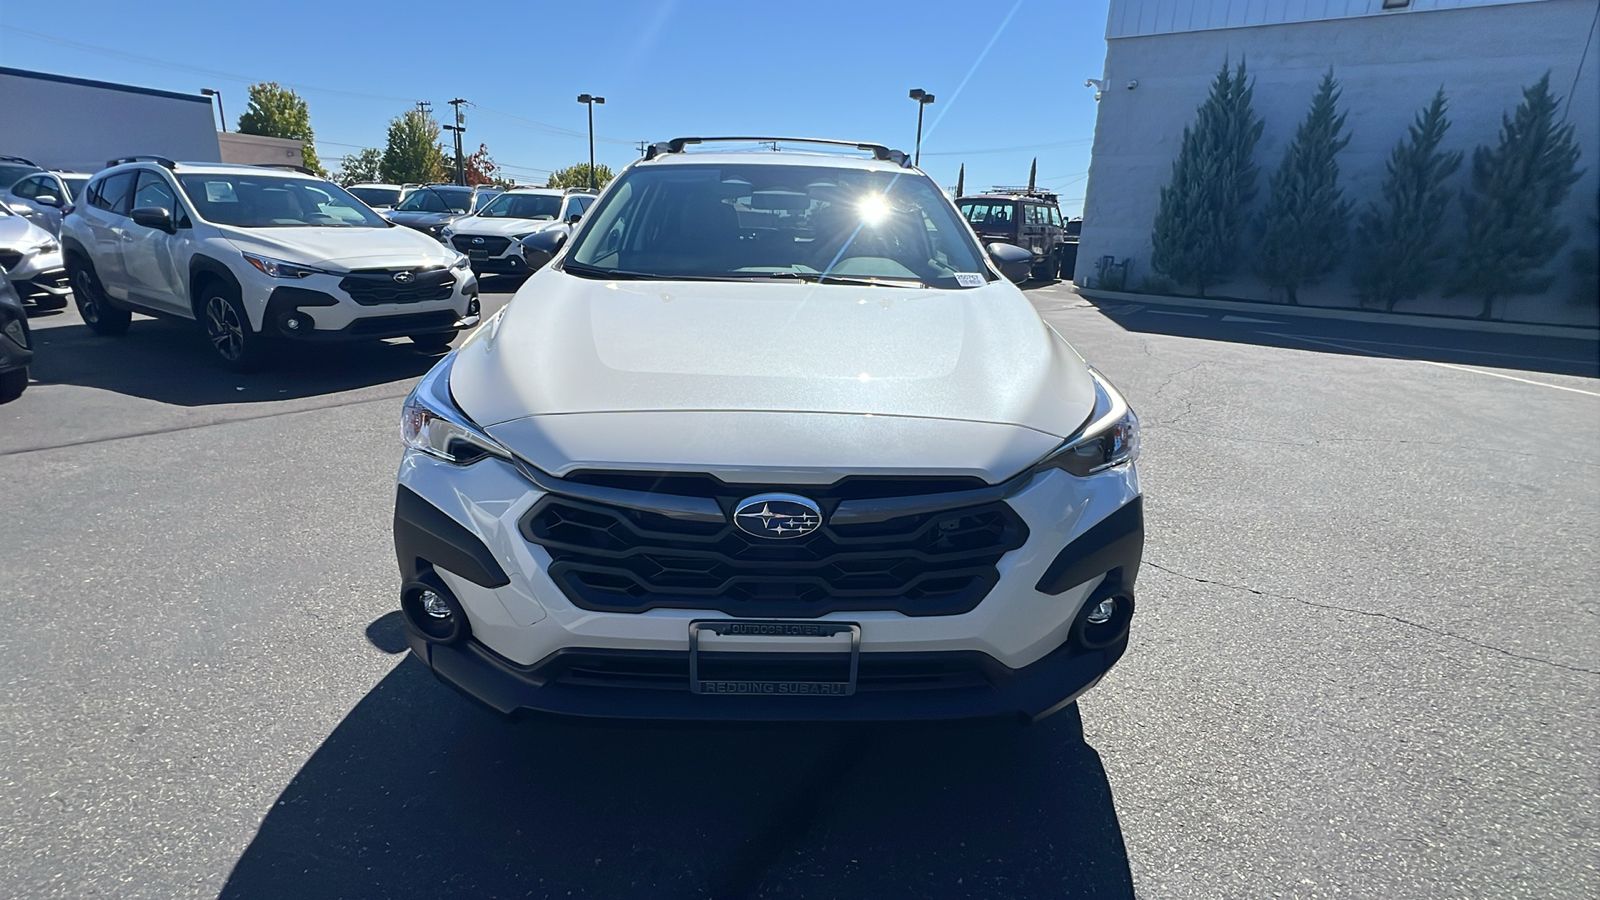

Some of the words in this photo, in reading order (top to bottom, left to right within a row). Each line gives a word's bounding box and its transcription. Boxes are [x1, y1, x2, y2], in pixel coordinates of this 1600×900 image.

[732, 624, 783, 635] OUTDOOR
[786, 625, 819, 636] LOVER
[705, 682, 773, 694] REDDING
[778, 683, 841, 695] SUBARU
